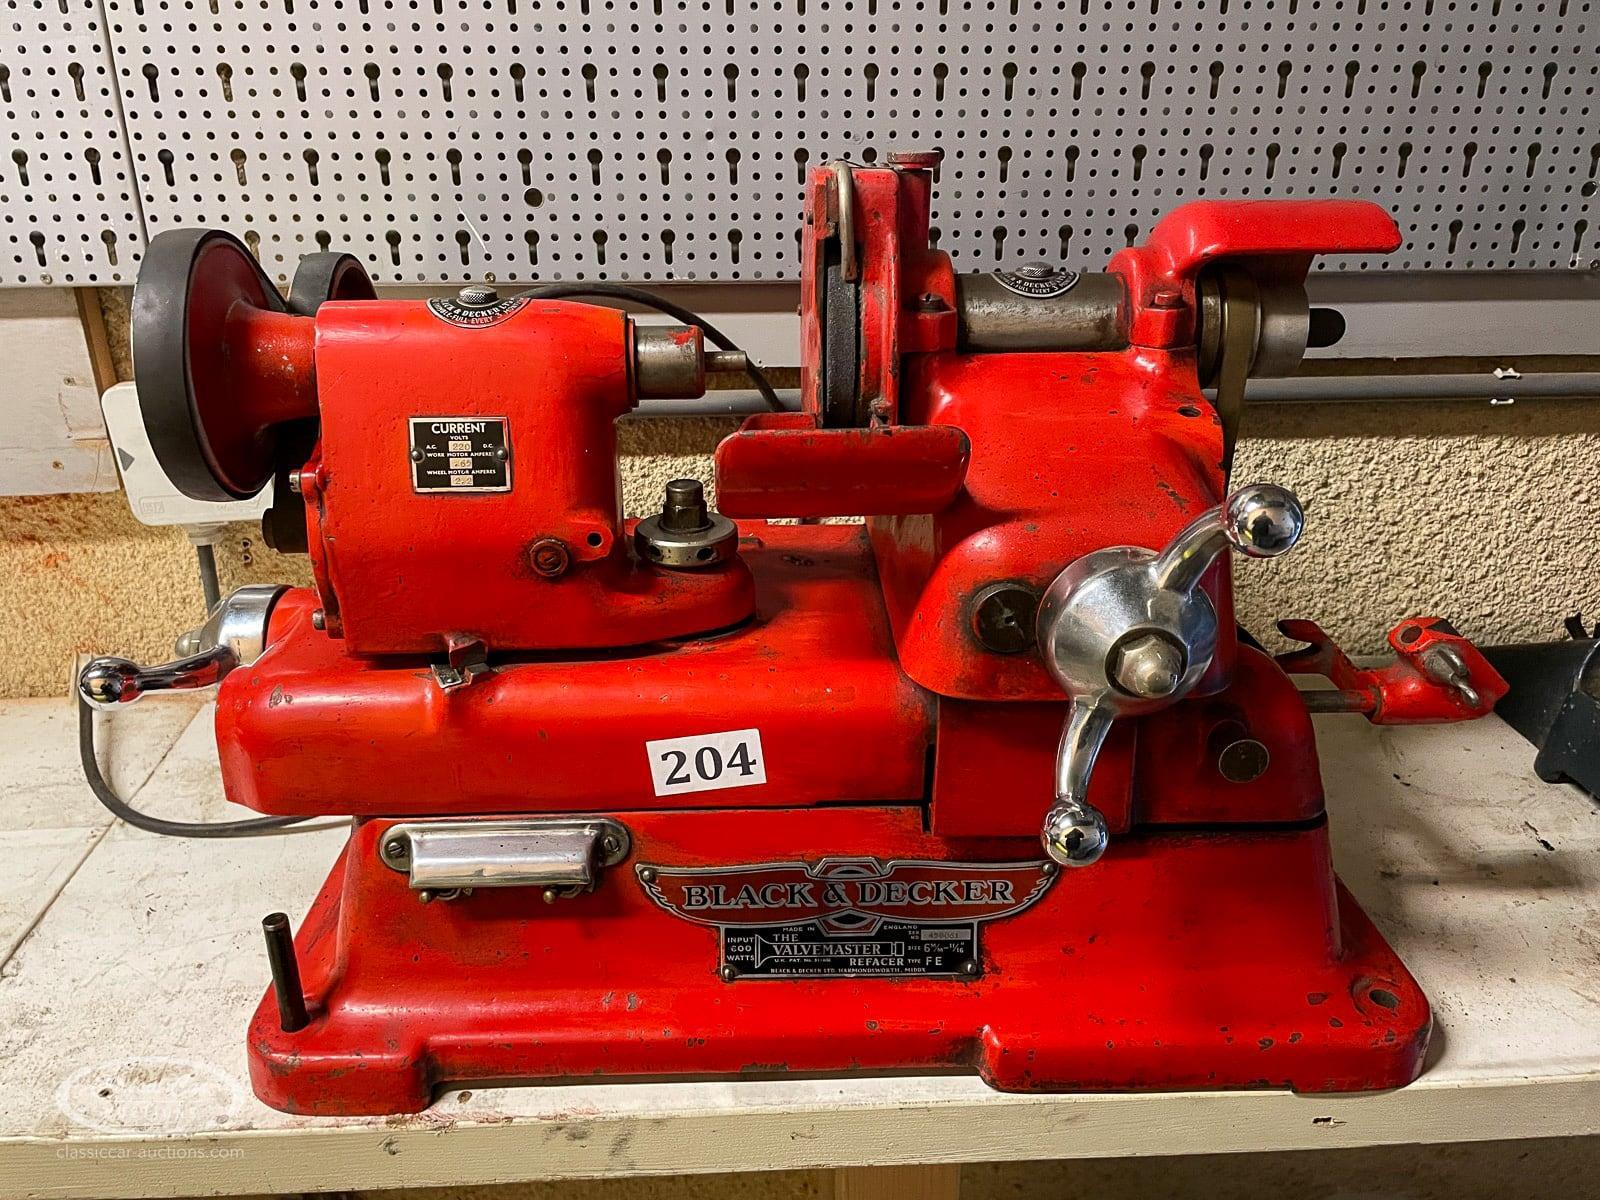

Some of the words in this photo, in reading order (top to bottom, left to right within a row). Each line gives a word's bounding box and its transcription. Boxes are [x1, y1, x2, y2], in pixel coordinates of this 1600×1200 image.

[462, 307, 500, 318] DECKER
[471, 316, 493, 324] EVERY
[431, 423, 486, 434] CURRENT
[661, 742, 757, 785] 204
[682, 882, 818, 910] BLACK
[822, 881, 852, 907] &
[856, 879, 1016, 906] DECKER
[772, 934, 799, 942] THE
[772, 944, 881, 955] VALVEMASTER
[849, 958, 904, 966] REFACER
